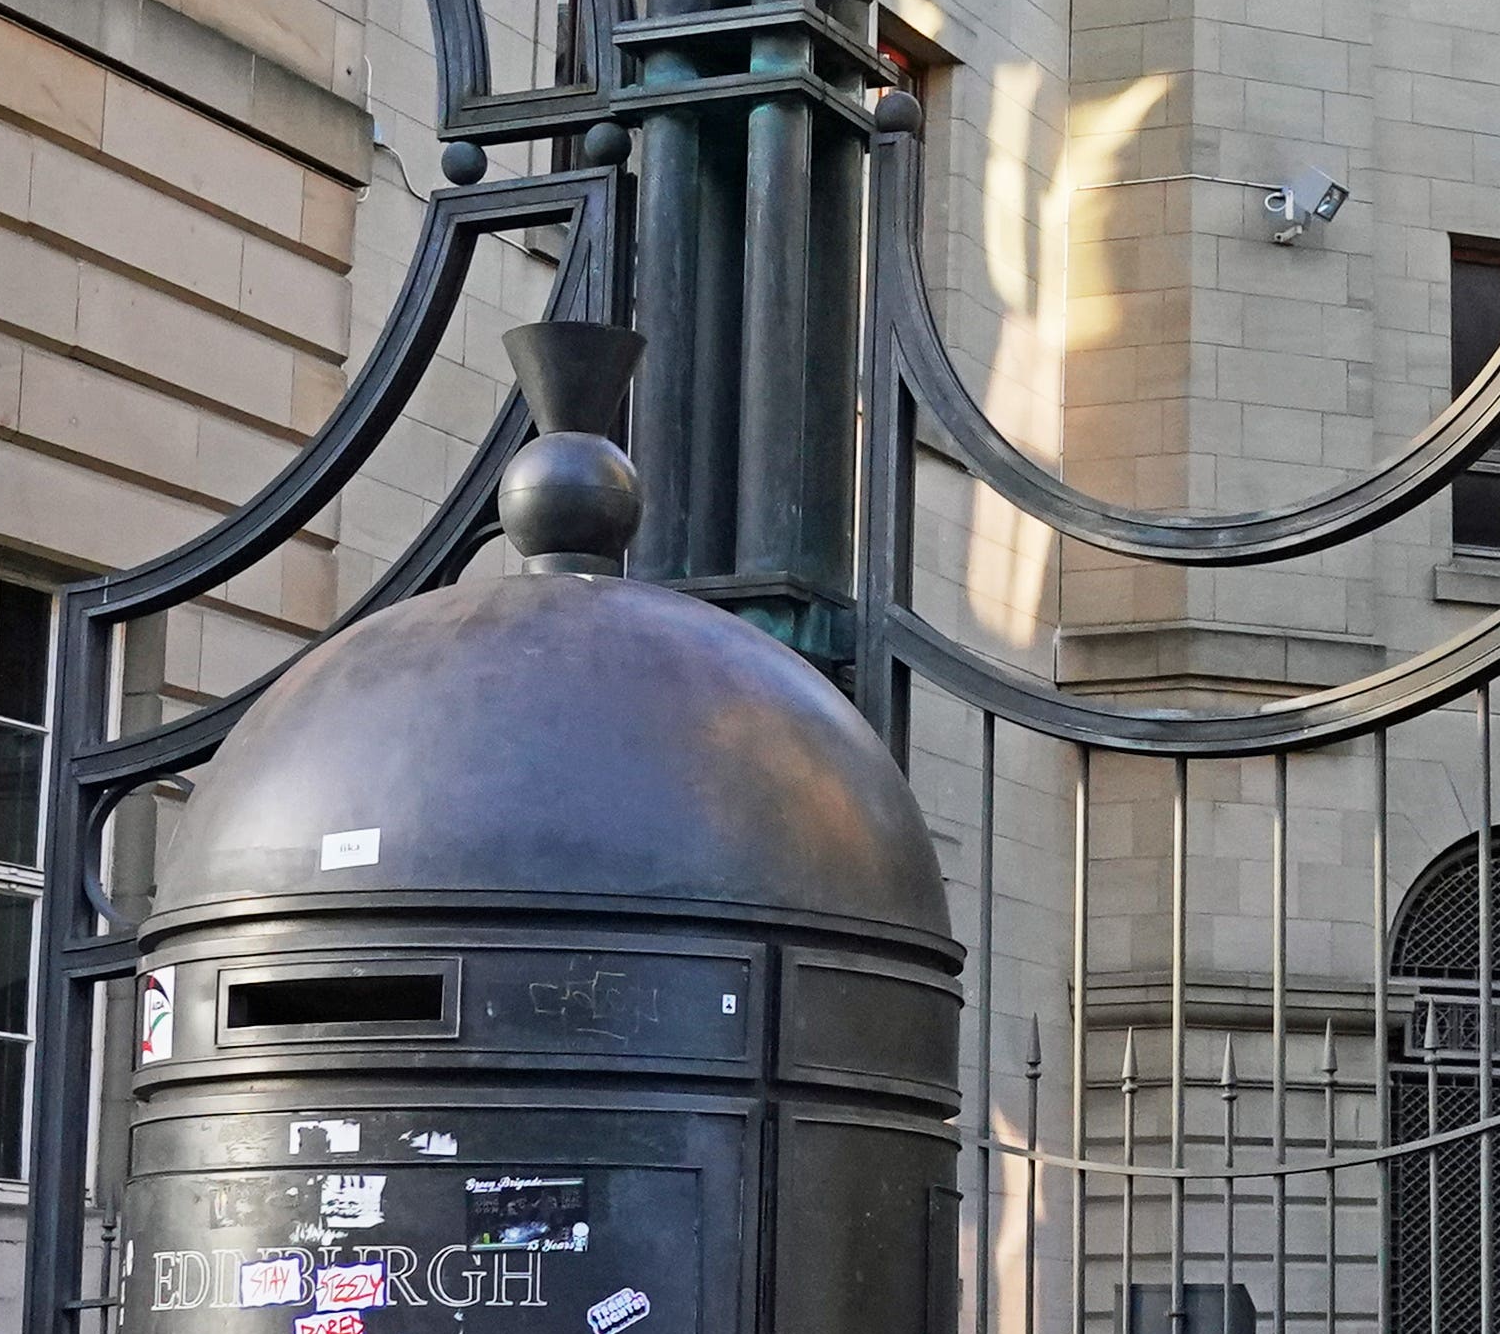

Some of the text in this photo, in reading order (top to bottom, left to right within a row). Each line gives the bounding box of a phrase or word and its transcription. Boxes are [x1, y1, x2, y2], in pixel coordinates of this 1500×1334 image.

[498, 1176, 542, 1191] Brigade
[542, 1239, 574, 1251] Years
[251, 1267, 290, 1300] STAY
